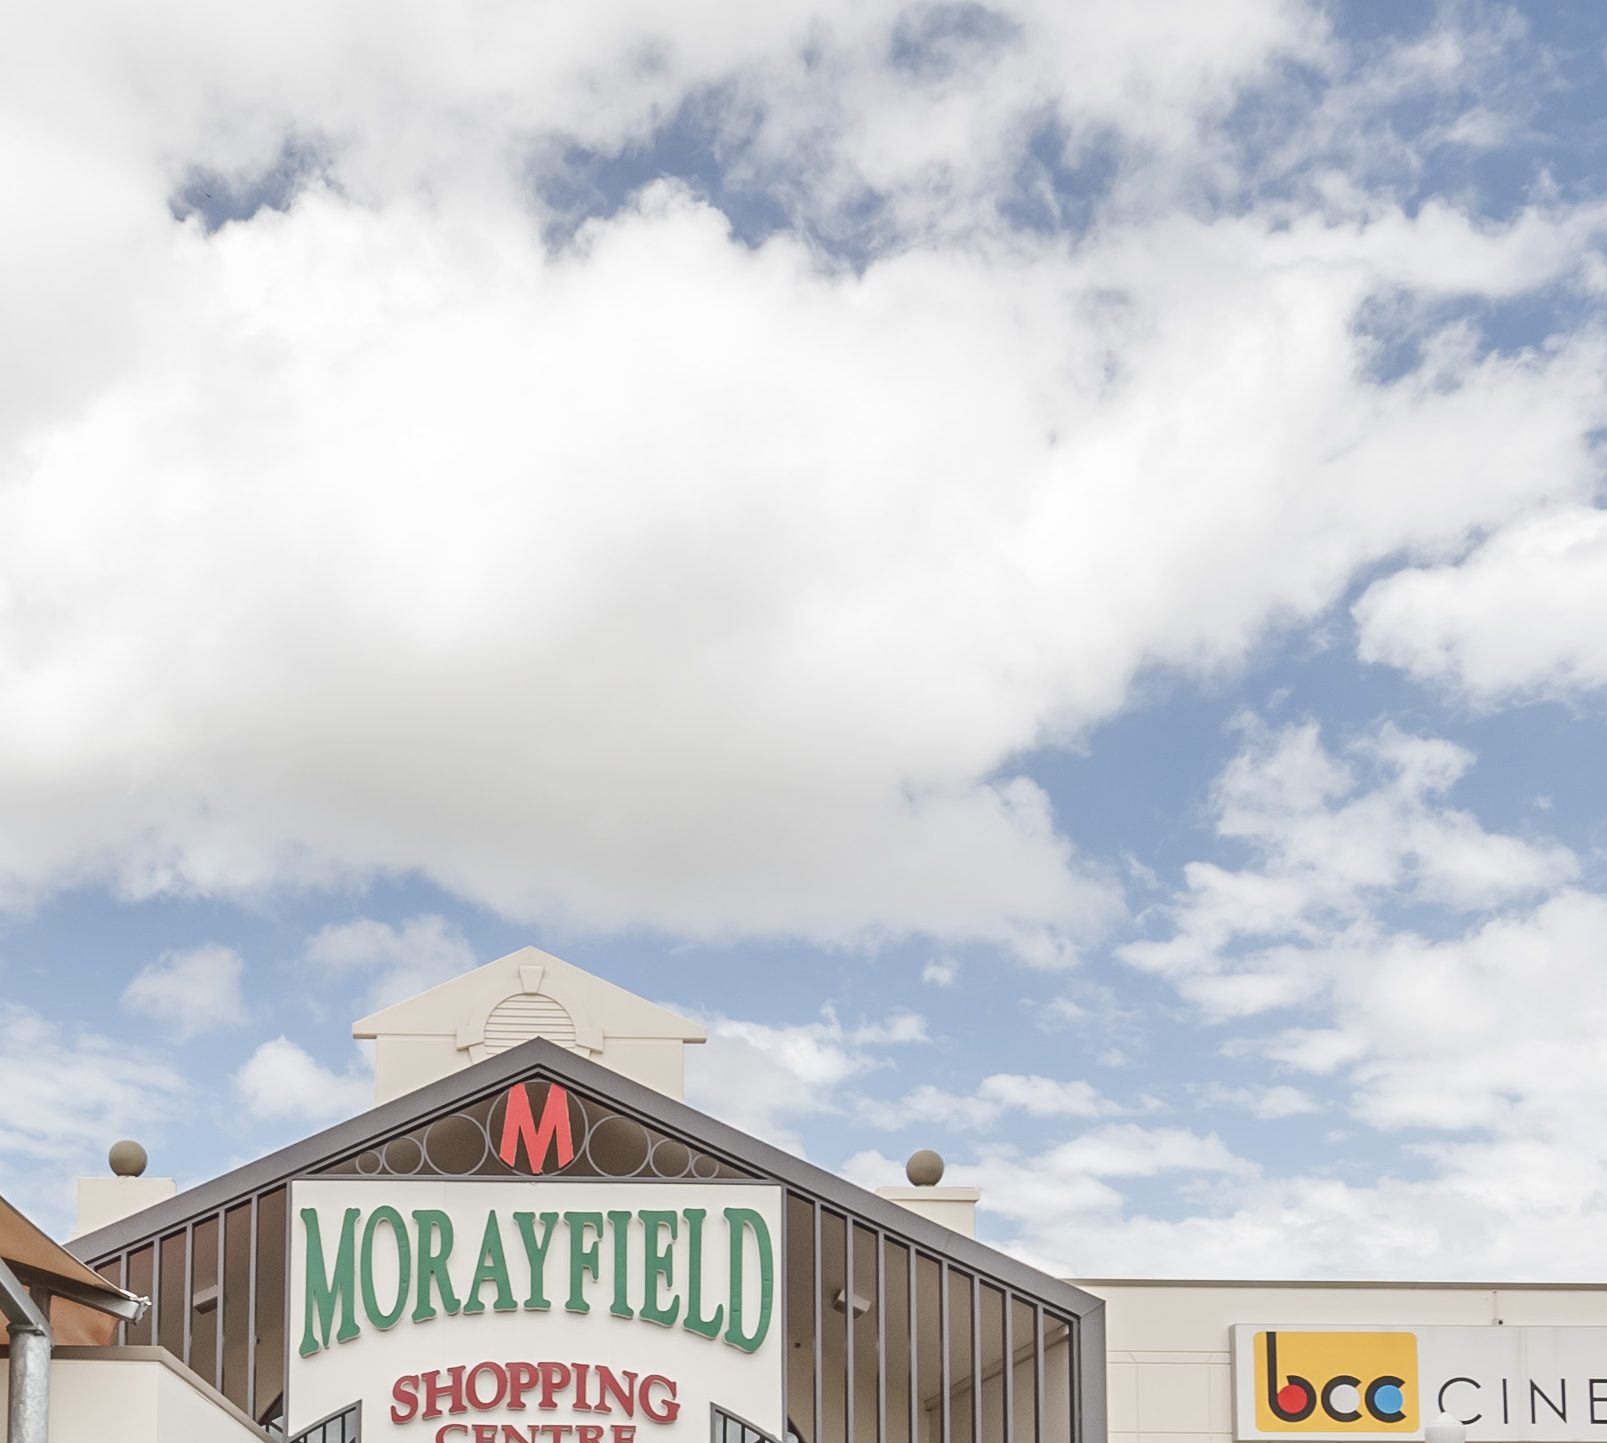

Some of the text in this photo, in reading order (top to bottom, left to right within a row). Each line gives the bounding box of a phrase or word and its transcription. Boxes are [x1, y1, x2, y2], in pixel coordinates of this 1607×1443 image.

[500, 1083, 574, 1175] M
[299, 1205, 774, 1359] MORAYFIELD
[391, 1361, 681, 1424] SHOPPING
[1266, 1331, 1407, 1423] bcc
